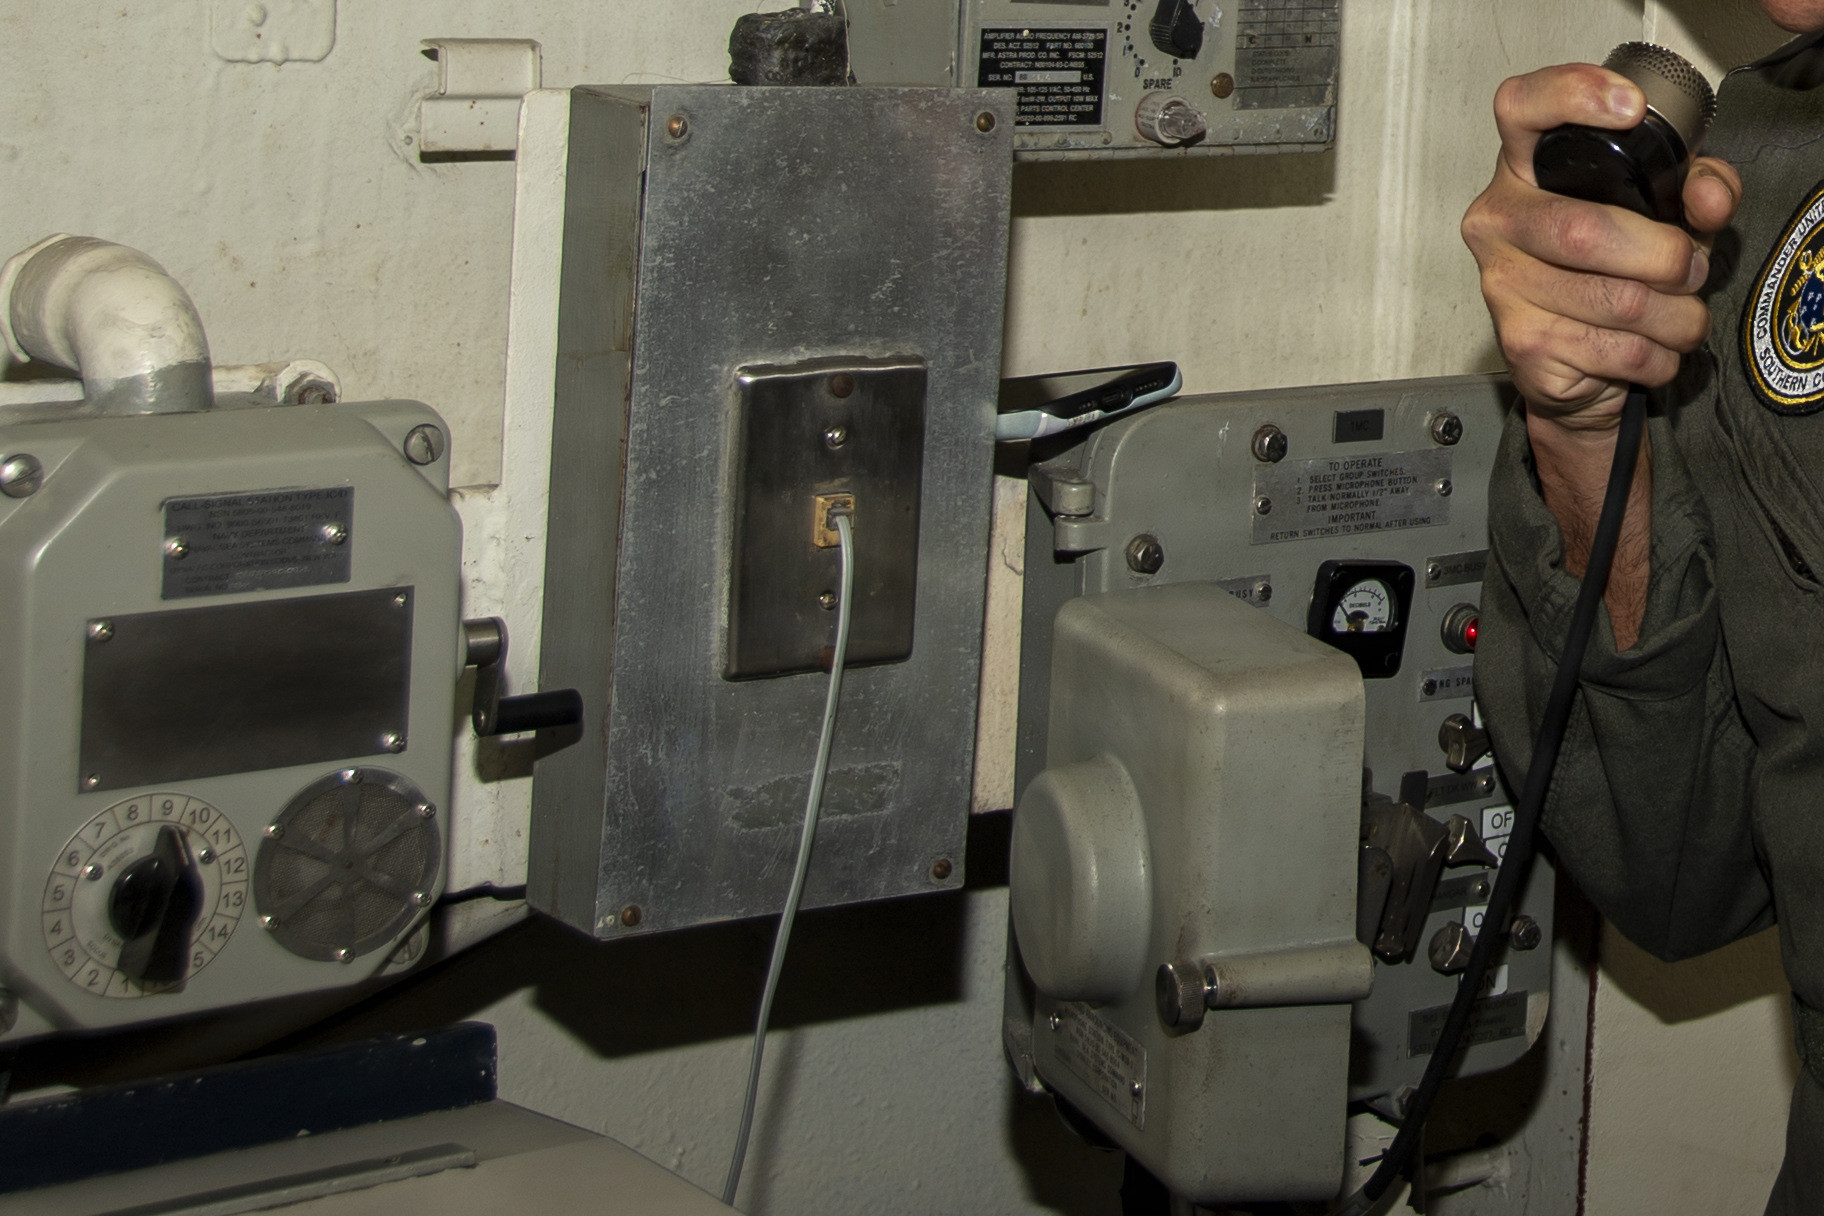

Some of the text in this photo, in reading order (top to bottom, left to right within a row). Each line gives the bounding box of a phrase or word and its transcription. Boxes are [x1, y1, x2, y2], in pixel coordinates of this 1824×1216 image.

[984, 32, 1015, 40] AMPLIFIER
[1035, 32, 1071, 40] FREQUENCY
[1116, 22, 1123, 33] 2
[1046, 42, 1062, 50] PART
[1063, 42, 1073, 50] NO.
[997, 51, 1017, 59] ASTRA
[1142, 78, 1172, 90] SPARE
[1048, 96, 1072, 104] OUTPUT
[1756, 238, 1799, 340] COMMANDER
[1759, 344, 1809, 391] SOUTHERN
[1349, 420, 1370, 432] 1MC
[1329, 458, 1383, 472] TO OPERATE
[1308, 484, 1333, 494] PRESS
[1336, 479, 1386, 492] MICROPHONE
[1387, 476, 1418, 487] BUTTON
[1309, 474, 1337, 484] SELECT
[1339, 471, 1364, 482] GROUP
[243, 493, 293, 506] STATION
[295, 490, 324, 502] TYPE
[1307, 493, 1327, 503] TALK
[1329, 489, 1369, 500] NORMALLY
[1390, 485, 1410, 495] AWAY
[1306, 503, 1328, 513] FROM
[1327, 510, 1377, 525] IMPORTANT
[242, 524, 305, 539] DEPARTMENT
[1269, 515, 1432, 541] RETURN SWITCHES TO NORMAL AFTER USING
[127, 804, 139, 822] 8
[162, 799, 175, 816] 9
[189, 807, 210, 826] 10
[1492, 810, 1513, 830] OF
[95, 822, 107, 839] 7
[212, 828, 232, 845] 11
[67, 850, 79, 867] 6
[223, 858, 246, 876] 12
[53, 884, 65, 902] 5
[222, 890, 244, 908] 13
[49, 919, 61, 935] 4
[208, 921, 229, 941] 14
[63, 949, 75, 966] 3
[87, 969, 99, 988] 2
